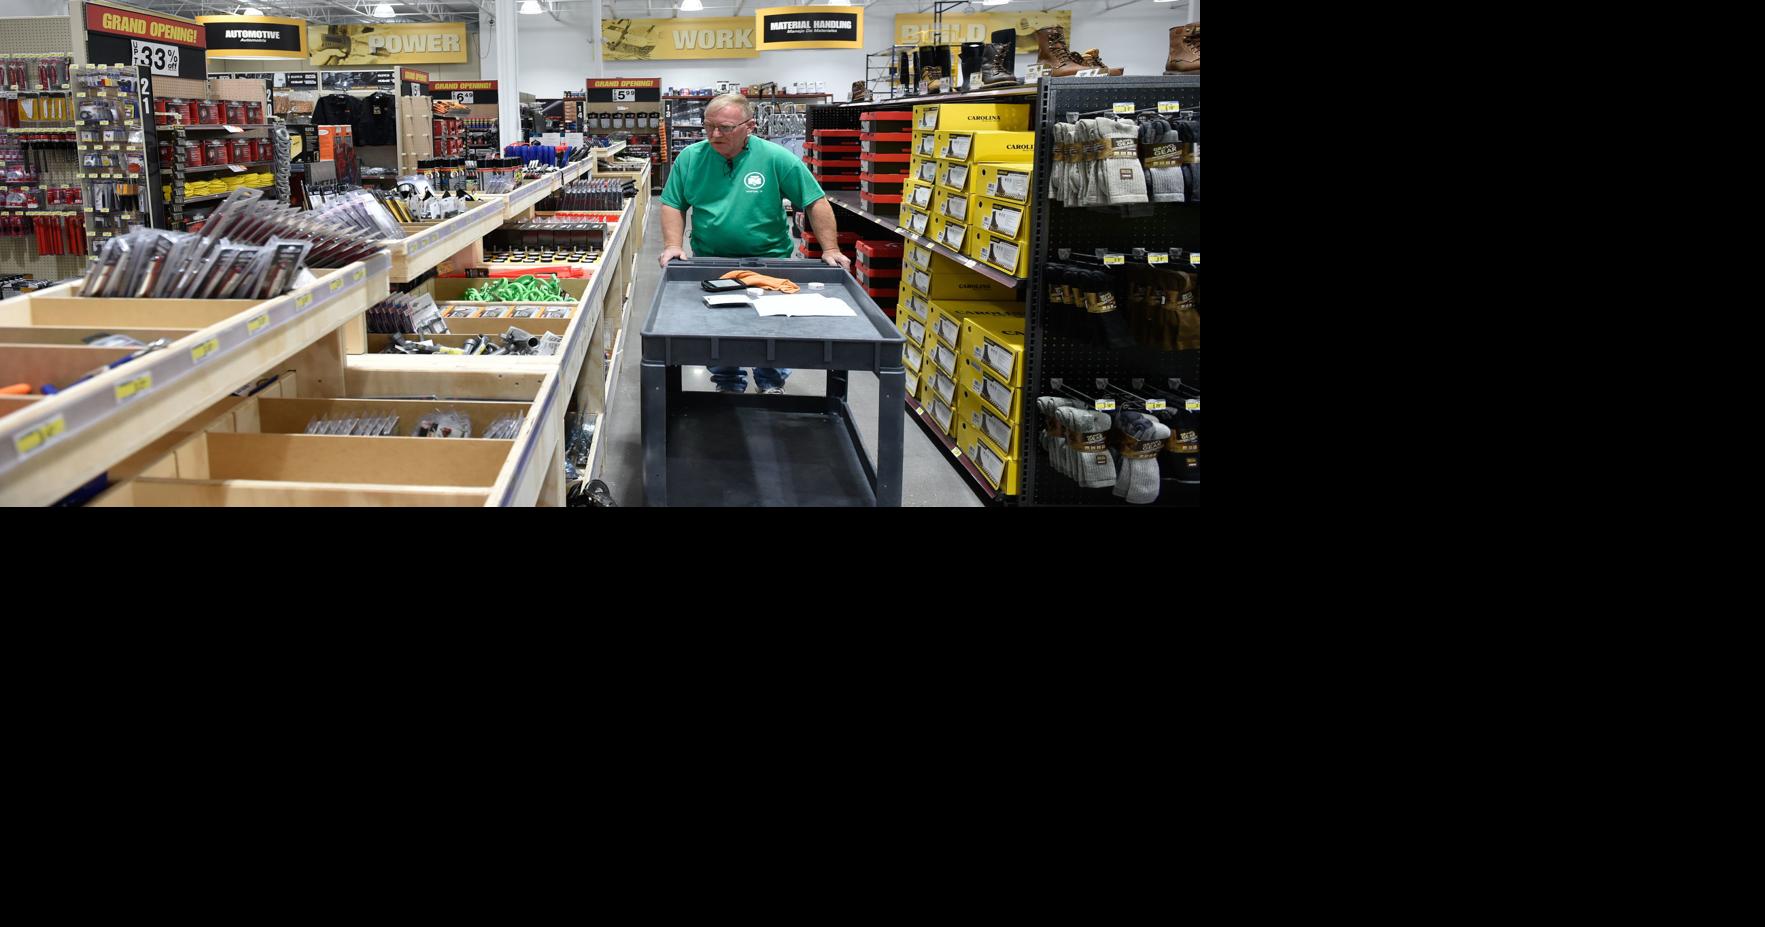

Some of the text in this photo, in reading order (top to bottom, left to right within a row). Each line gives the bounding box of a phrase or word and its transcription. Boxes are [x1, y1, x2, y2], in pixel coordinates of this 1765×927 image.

[102, 13, 198, 44] GRAND OPENING!
[225, 29, 281, 40] AUTOMOTIVE
[770, 20, 852, 31] MATERIAL HANDLING
[901, 23, 986, 44] BUILD
[367, 33, 460, 54] POWER
[672, 28, 753, 50] WORK
[434, 82, 492, 90] GRAND OPENING!
[594, 80, 654, 88] GRAND OPENING!
[140, 77, 150, 114] 21
